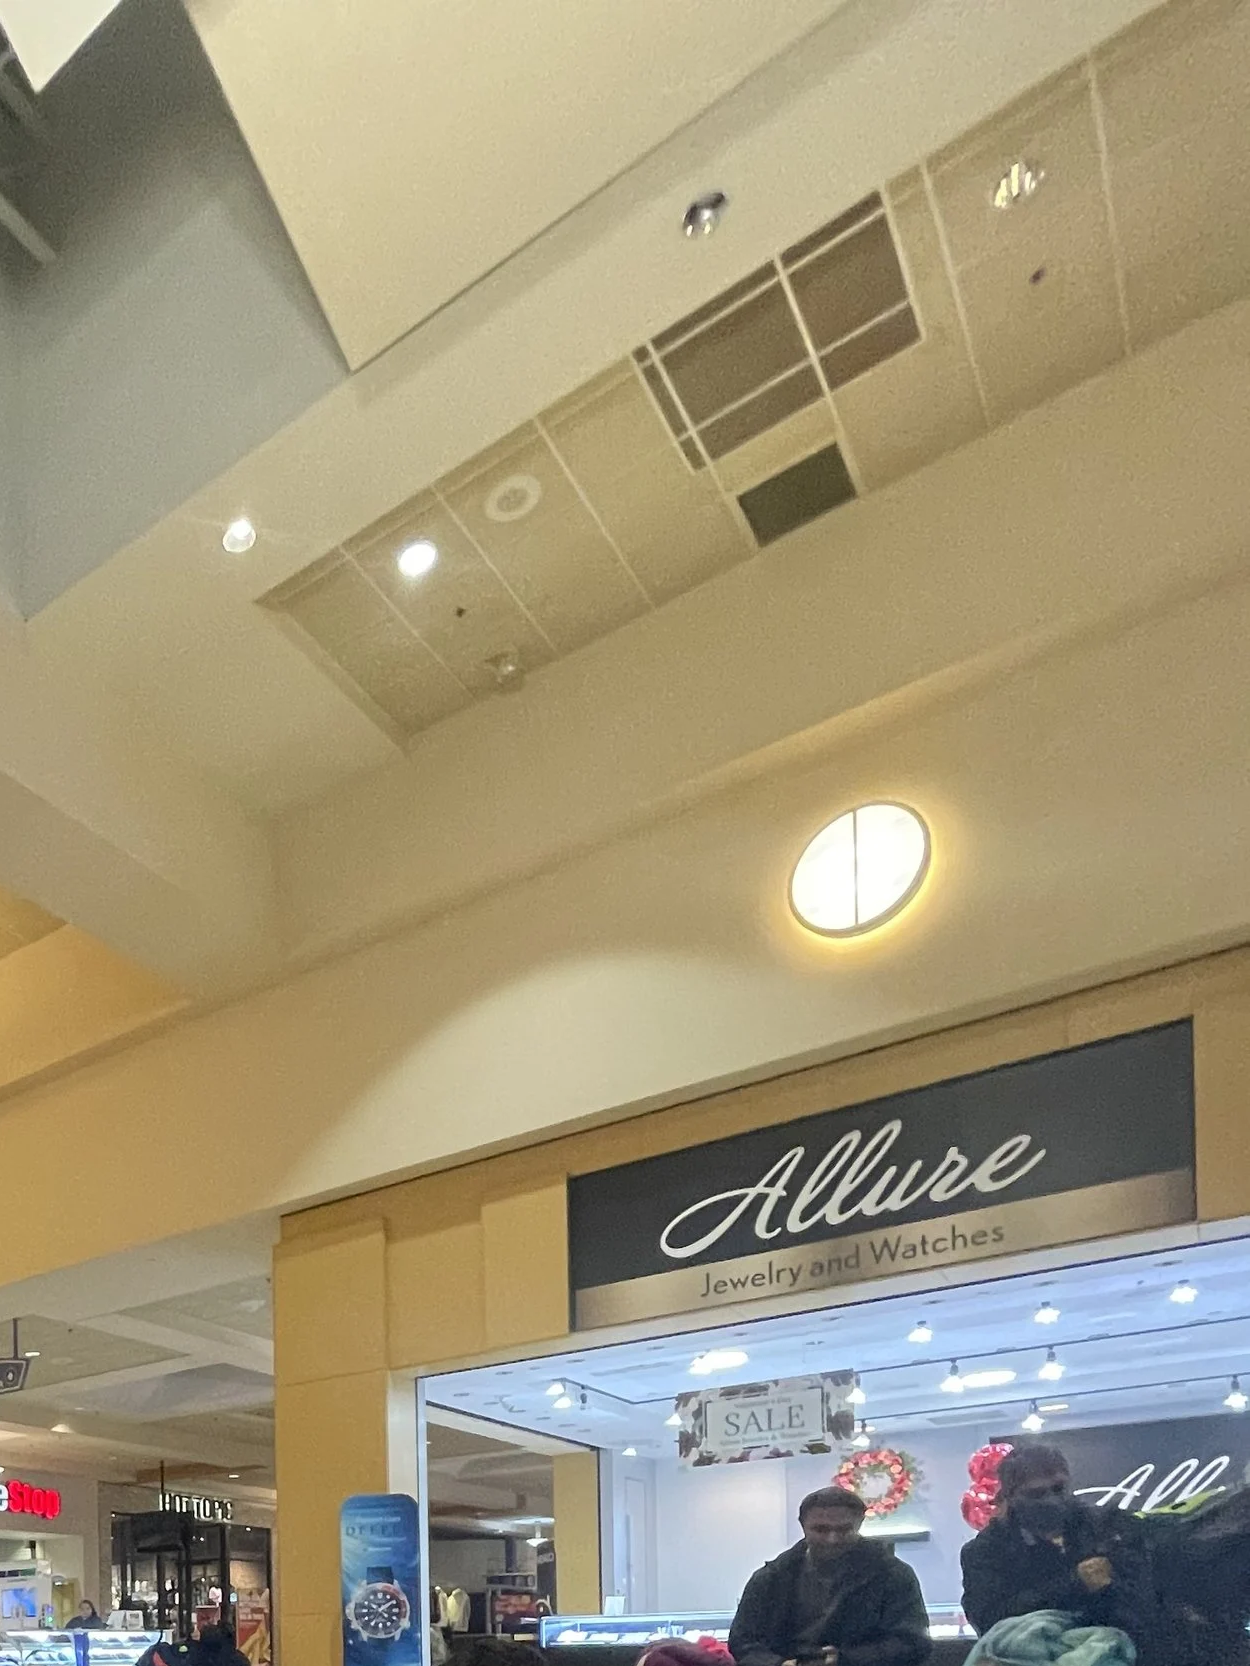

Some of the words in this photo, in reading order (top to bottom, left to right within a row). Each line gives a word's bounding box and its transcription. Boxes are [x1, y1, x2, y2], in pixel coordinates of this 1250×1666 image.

[659, 1119, 1046, 1258] Allure
[701, 1260, 803, 1297] Jewelry
[810, 1248, 860, 1278] and
[870, 1225, 1005, 1265] Watches
[724, 1404, 805, 1437] SALE
